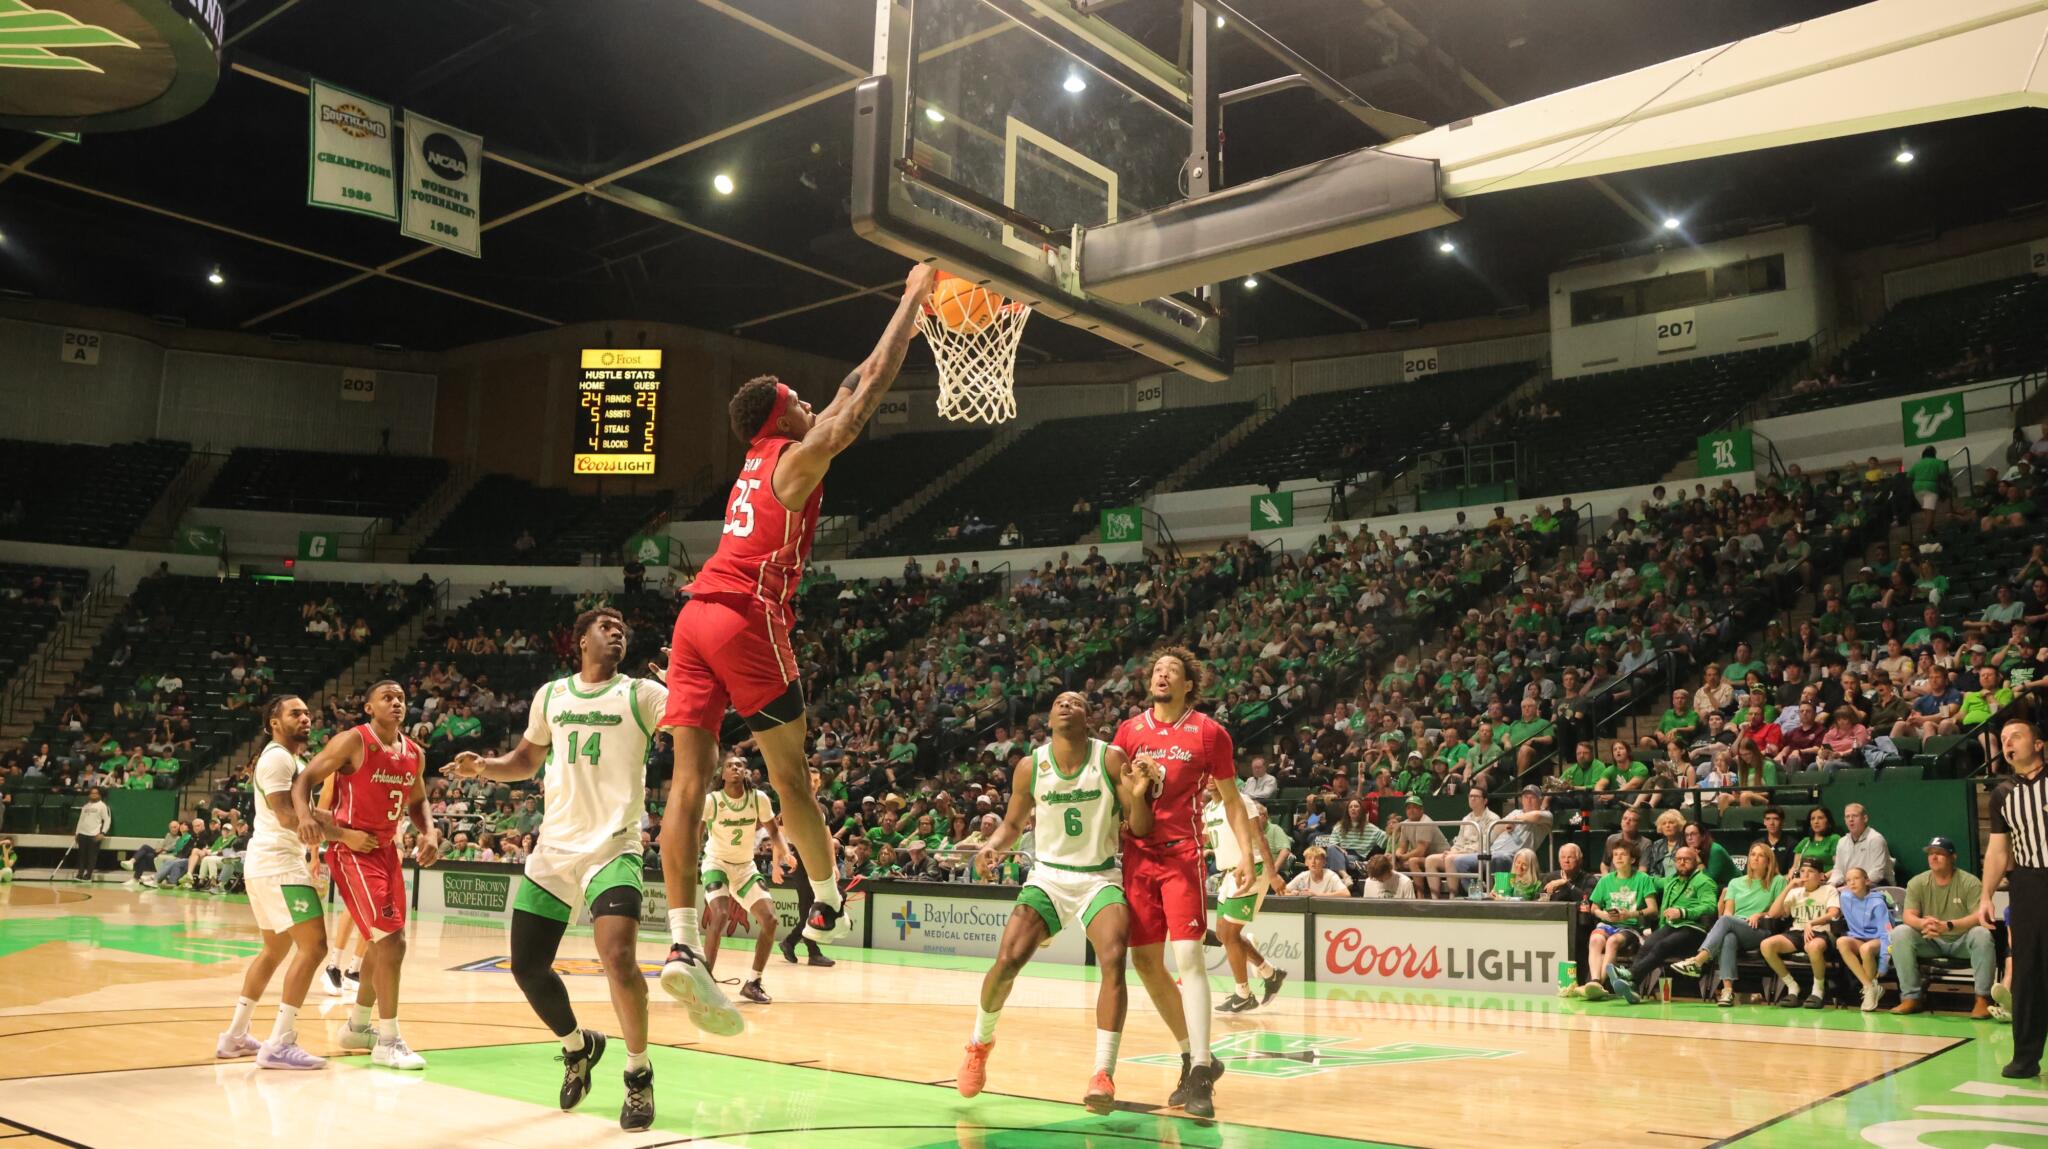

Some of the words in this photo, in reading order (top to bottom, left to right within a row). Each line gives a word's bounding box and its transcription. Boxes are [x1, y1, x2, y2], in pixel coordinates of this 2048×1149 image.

[321, 105, 386, 139] SOUTHLAND
[317, 152, 391, 179] CHAMPIONS
[428, 151, 467, 173] NCAA
[341, 187, 372, 203] 1986
[421, 179, 469, 202] WOMEN'S
[411, 190, 475, 219] TOURNAMENT
[430, 219, 458, 237] 1986
[1658, 320, 1693, 338] 207
[64, 332, 99, 348] 202
[74, 348, 86, 360] A
[616, 352, 641, 365] Frost
[1405, 358, 1437, 373] 206
[585, 371, 622, 380] HUSTLE
[625, 371, 655, 380] STATS
[343, 378, 374, 392] 203
[579, 381, 605, 389] HOME
[634, 382, 660, 390] GUEST
[581, 392, 602, 407] 24
[605, 395, 632, 403] RBNDS
[636, 392, 657, 407] 23
[1138, 387, 1161, 402] 205
[591, 407, 600, 422] 5
[605, 410, 631, 418] ASSISTS
[647, 407, 656, 421] 7
[880, 402, 907, 414] 204
[604, 425, 630, 433] STEALS
[645, 422, 654, 437] 2
[589, 437, 599, 451] 4
[602, 440, 628, 448] BLOCKS
[644, 437, 654, 452] 2
[1712, 438, 1736, 470] R
[577, 456, 617, 472] Coors
[617, 461, 652, 471] LIGHT
[723, 479, 761, 538] 35
[567, 730, 601, 765] 14
[1168, 745, 1192, 762] State
[370, 768, 404, 785] Arkansas
[387, 790, 403, 821] 3
[1064, 807, 1083, 837] 6
[731, 828, 743, 846] 2
[445, 876, 473, 890] SCOTT
[474, 878, 507, 893] BROWN
[447, 891, 504, 908] PROPERTIES
[924, 903, 1008, 928] BaylorScott
[924, 930, 960, 941] MEDICAL
[963, 932, 997, 942] CENTER
[1324, 927, 1442, 979] Coors
[1447, 947, 1556, 984] LIGHT
